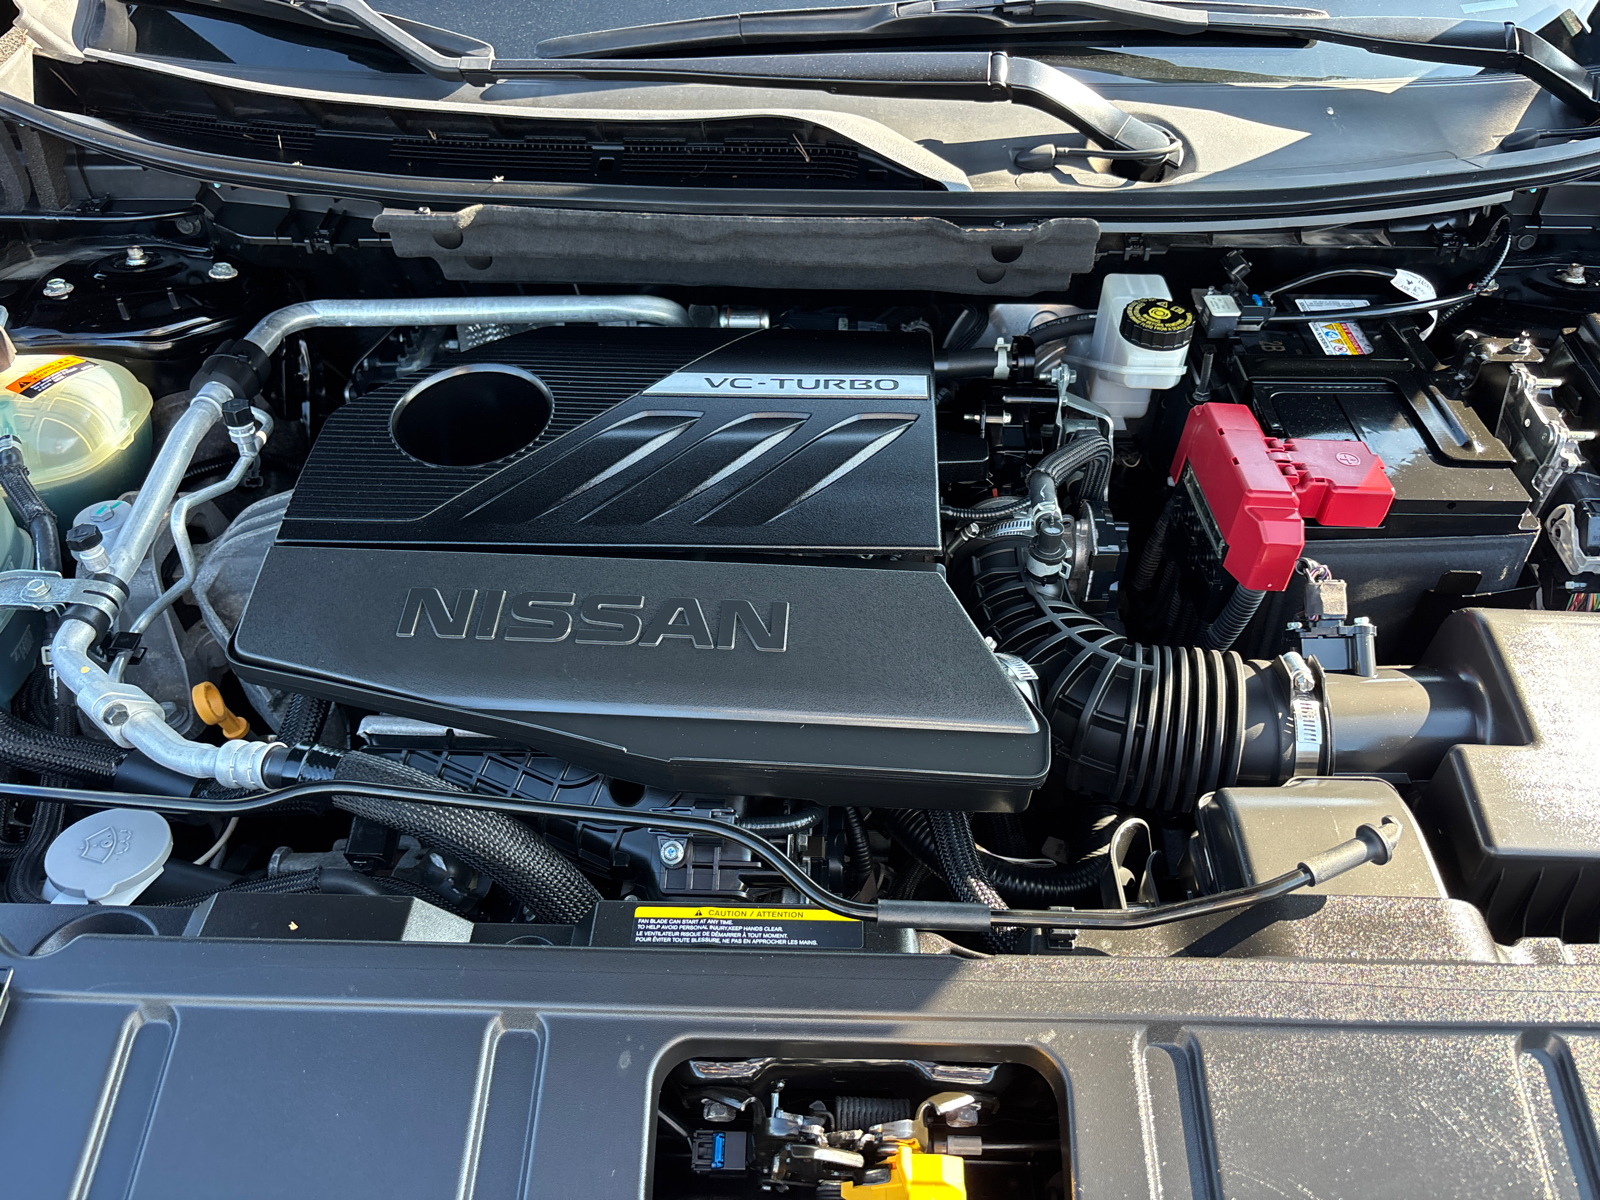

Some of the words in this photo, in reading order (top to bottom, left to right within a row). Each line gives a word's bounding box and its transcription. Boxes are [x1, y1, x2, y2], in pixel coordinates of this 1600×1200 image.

[703, 376, 900, 391] VC-TURBO
[396, 586, 790, 653] NISSAN
[708, 909, 747, 918] CAUTION
[756, 911, 804, 919] ATTENTION
[652, 935, 671, 943] ÉVITER
[710, 930, 742, 938] DÉMARRER
